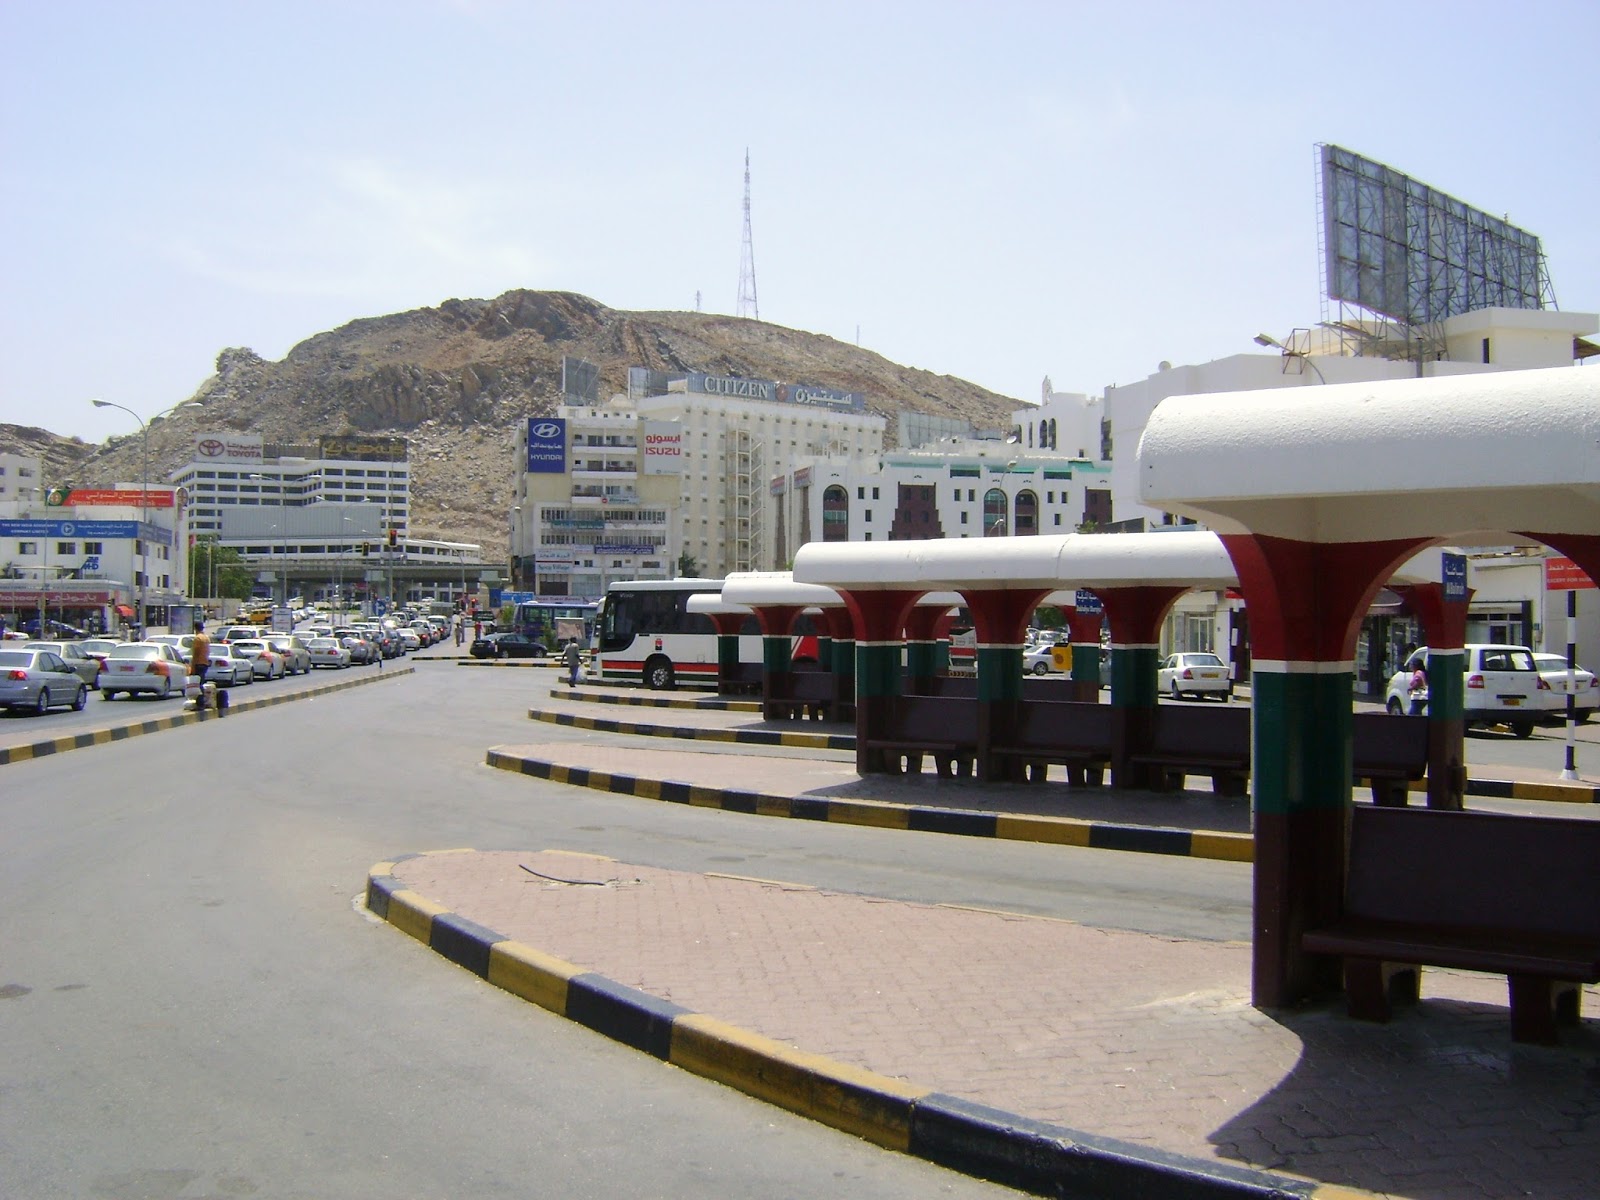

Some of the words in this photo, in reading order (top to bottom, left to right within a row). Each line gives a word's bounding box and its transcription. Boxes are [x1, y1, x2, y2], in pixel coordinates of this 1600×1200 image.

[704, 376, 769, 398] CITIZEN
[646, 435, 681, 444] ايسوزو
[227, 450, 262, 458] TOYOTA
[645, 447, 681, 456] ISUZU
